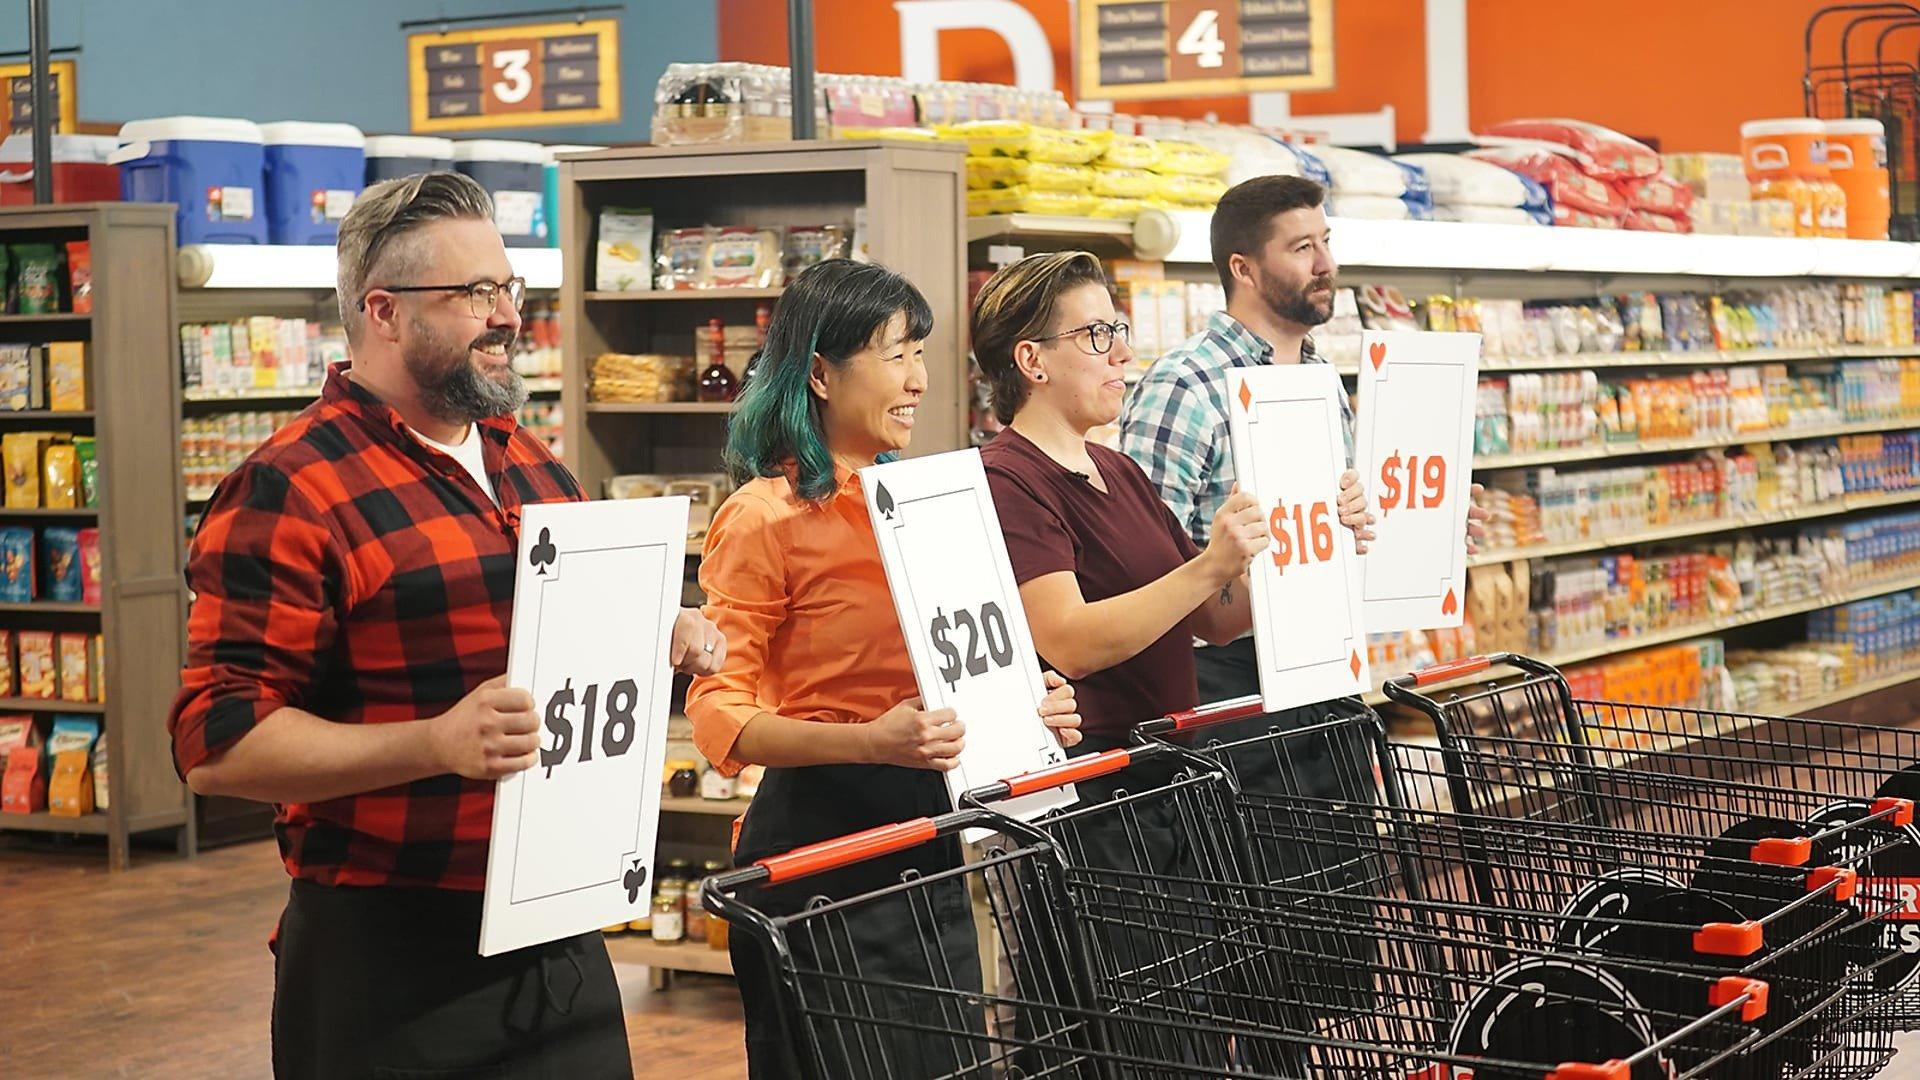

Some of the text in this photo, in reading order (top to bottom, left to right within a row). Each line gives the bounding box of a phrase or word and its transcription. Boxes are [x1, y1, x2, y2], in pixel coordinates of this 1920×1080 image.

[1176, 10, 1225, 68] 4
[492, 49, 533, 104] 3
[1378, 449, 1446, 517] $19
[1269, 498, 1333, 576] $16
[930, 601, 1013, 693] $20
[539, 678, 639, 779] $18
